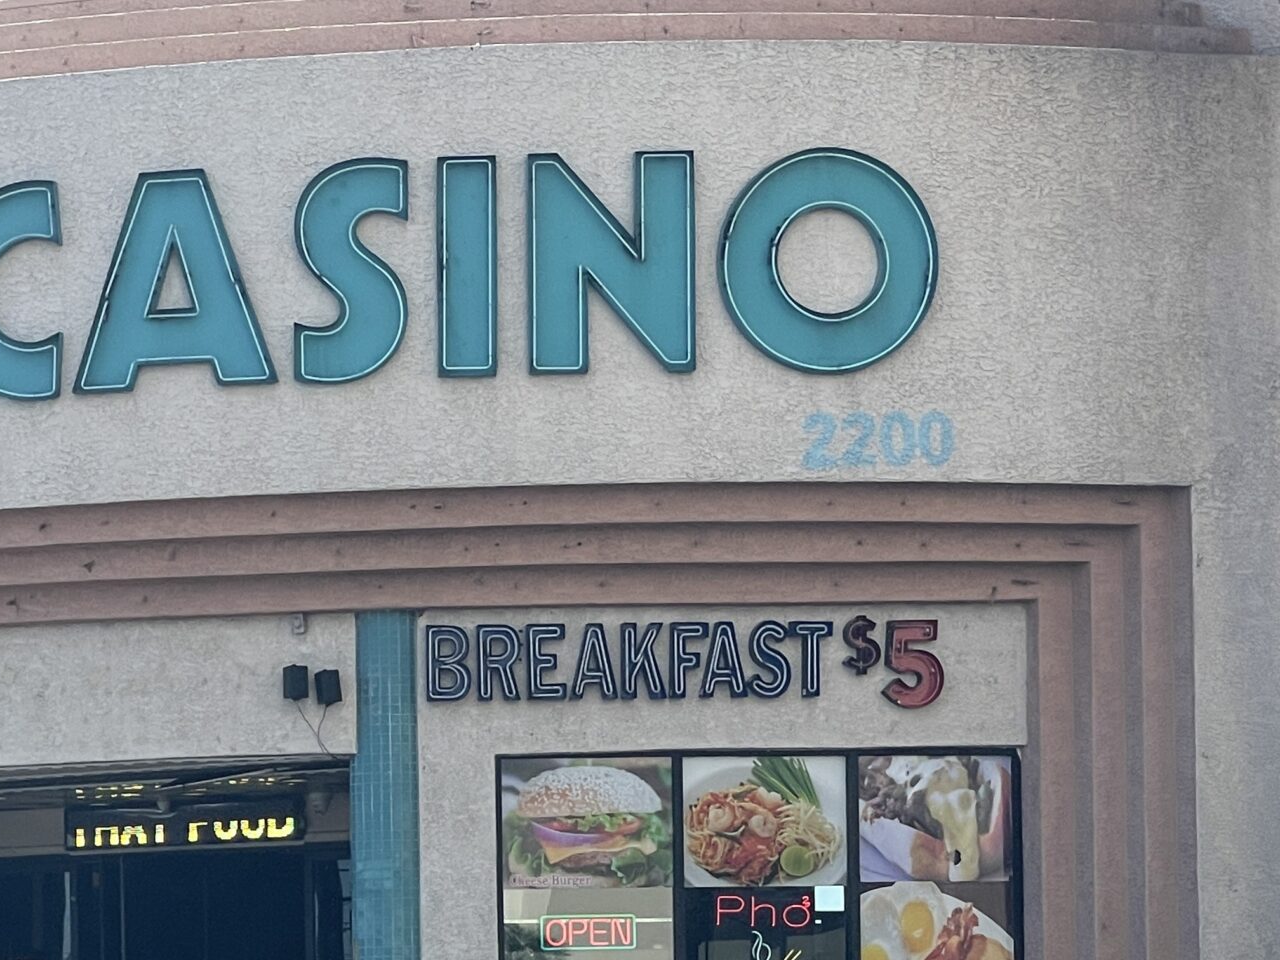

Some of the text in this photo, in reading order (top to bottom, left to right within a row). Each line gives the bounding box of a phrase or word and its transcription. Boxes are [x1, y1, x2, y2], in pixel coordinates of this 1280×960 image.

[801, 409, 955, 471] 2200
[424, 614, 945, 709] BREAKFAST $5
[552, 875, 592, 889] Burger
[545, 917, 632, 947] OPEN
